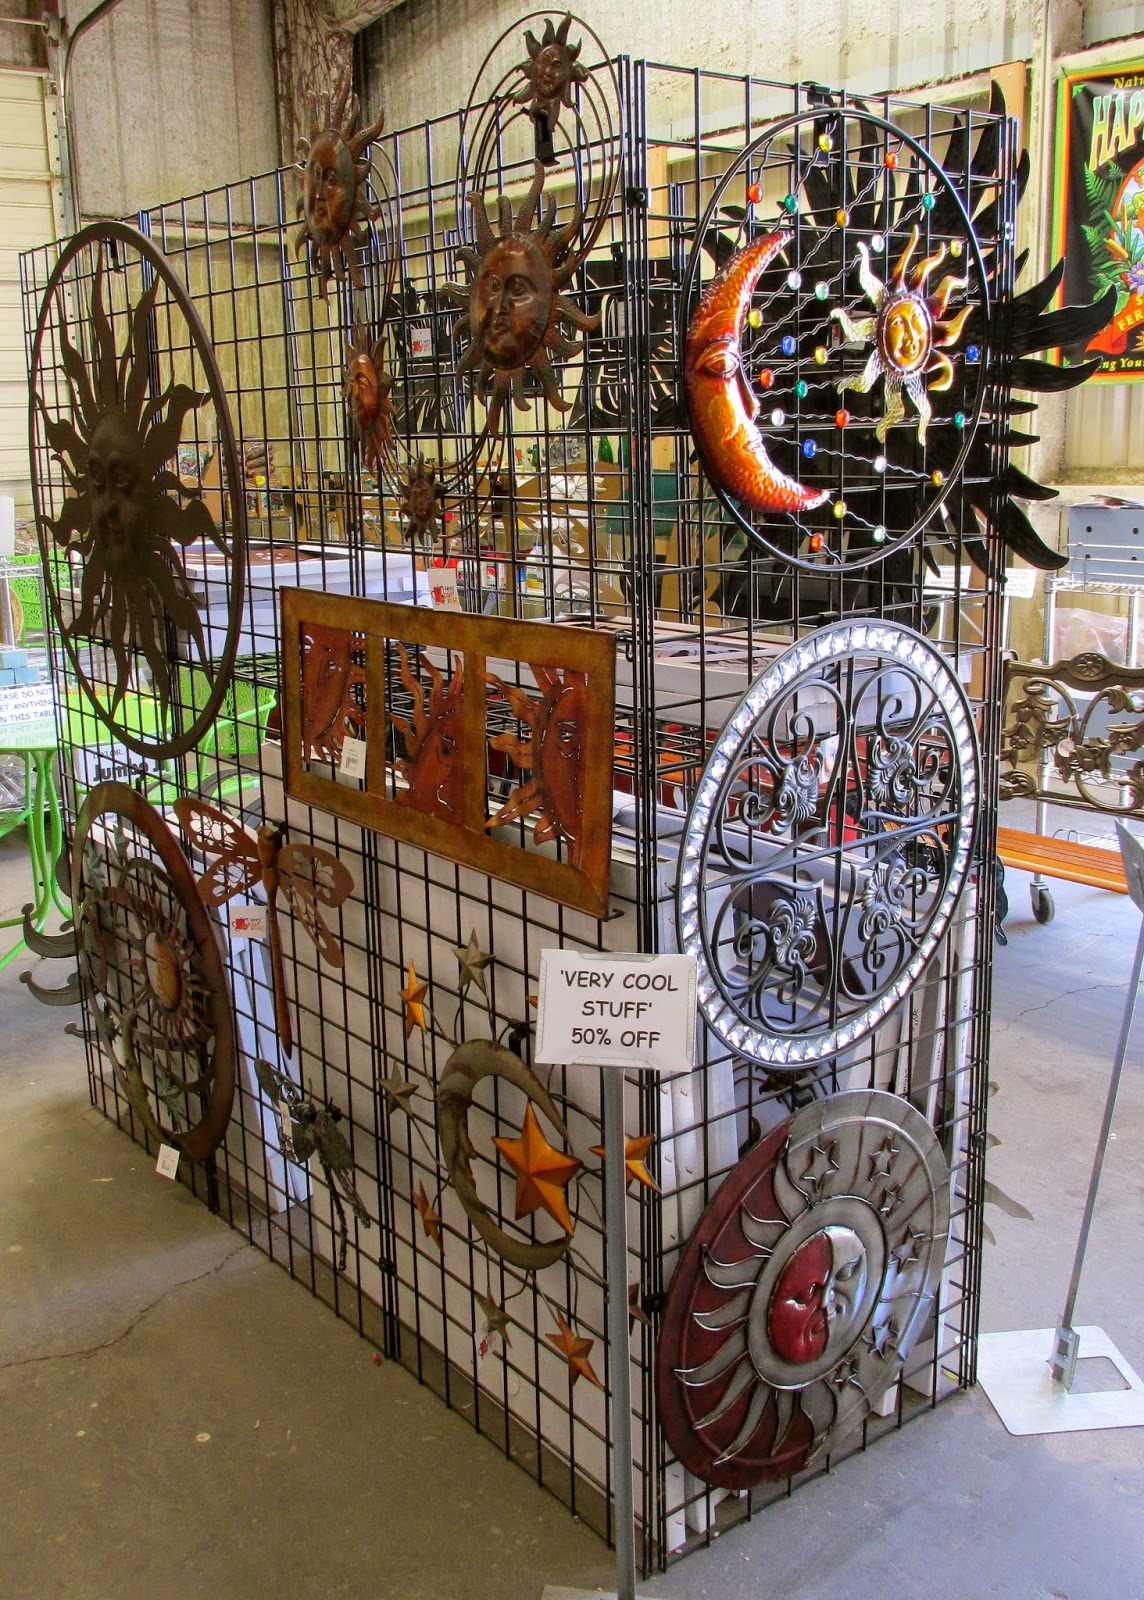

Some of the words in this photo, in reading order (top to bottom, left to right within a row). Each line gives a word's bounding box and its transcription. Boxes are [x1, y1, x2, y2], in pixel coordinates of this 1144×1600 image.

[1089, 89, 1144, 173] HAP
[1120, 357, 1144, 368] You
[21, 690, 33, 699] DO
[36, 687, 53, 696] NOT
[9, 712, 31, 722] THIS
[33, 709, 56, 718] TABL
[93, 758, 149, 782] Jumbo
[560, 969, 614, 988] 'VERY
[622, 973, 678, 992] COOL
[581, 1000, 652, 1019] STUFF'
[571, 1027, 612, 1045] 50%
[620, 1030, 661, 1049] OFF
